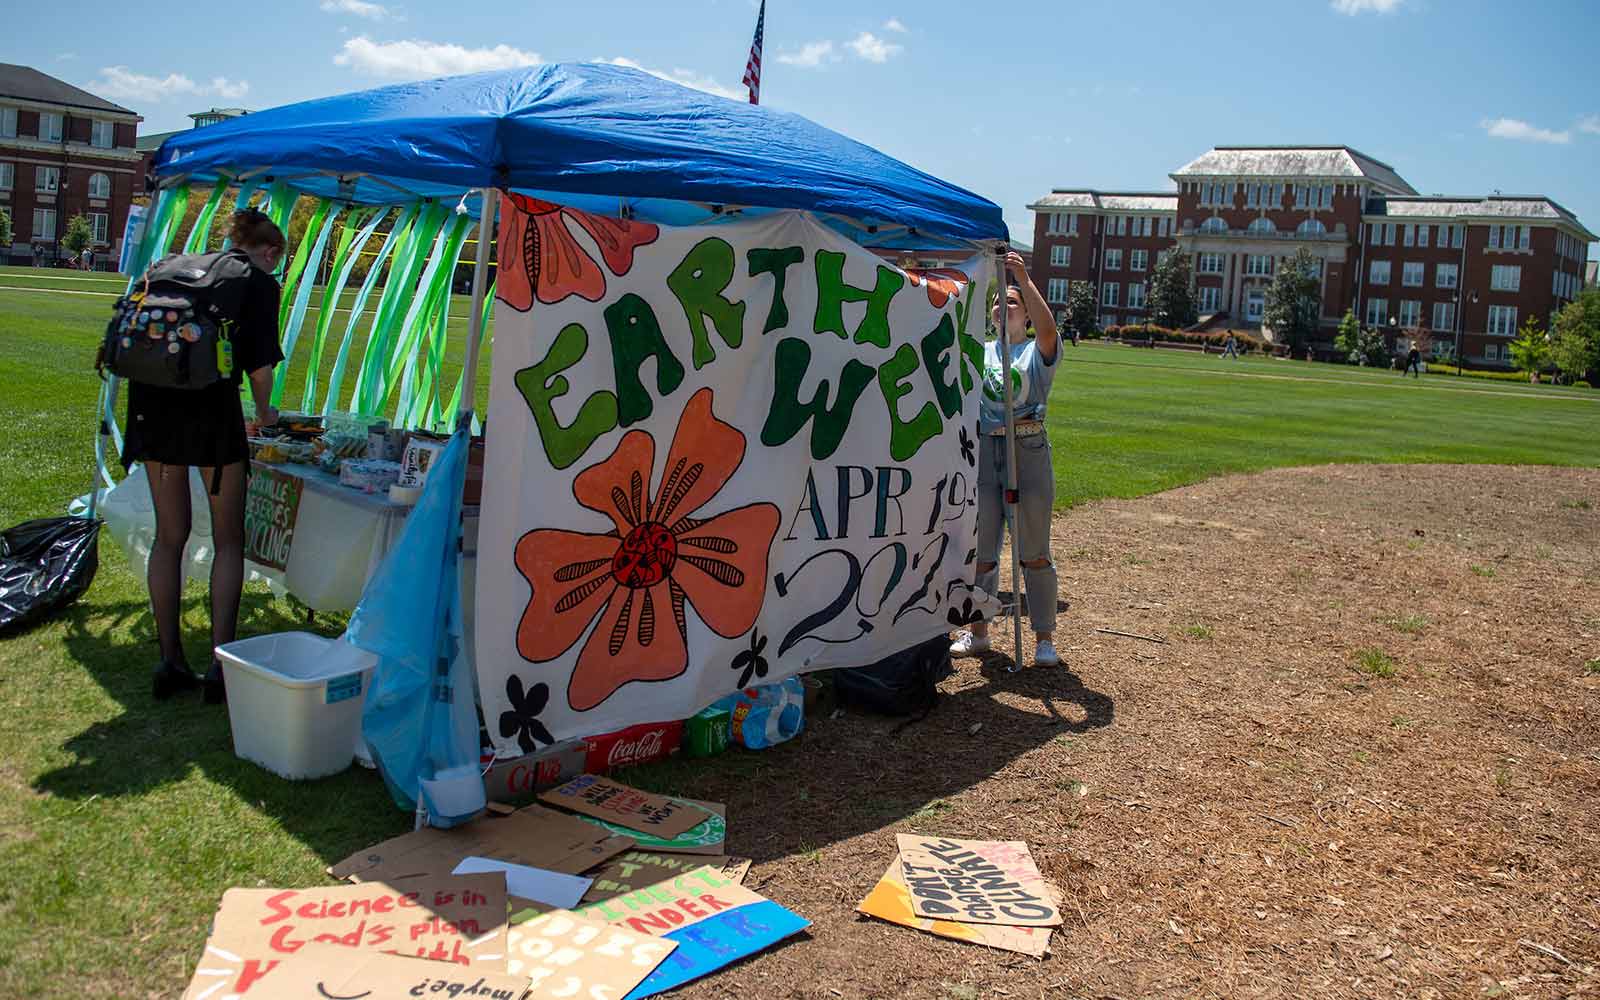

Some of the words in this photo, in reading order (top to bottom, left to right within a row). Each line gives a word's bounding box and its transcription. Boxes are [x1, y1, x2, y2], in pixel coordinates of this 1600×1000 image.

[514, 236, 905, 470] EARTH
[760, 279, 984, 462] WEEK
[783, 465, 913, 541] APR
[774, 532, 977, 658] 202
[607, 728, 666, 766] Coca-Cola
[260, 890, 420, 926] Science
[434, 890, 458, 907] is
[463, 889, 487, 906] in
[615, 893, 732, 935] NDER
[919, 839, 1054, 920] CLIMATE
[409, 978, 514, 1000] maybe?
